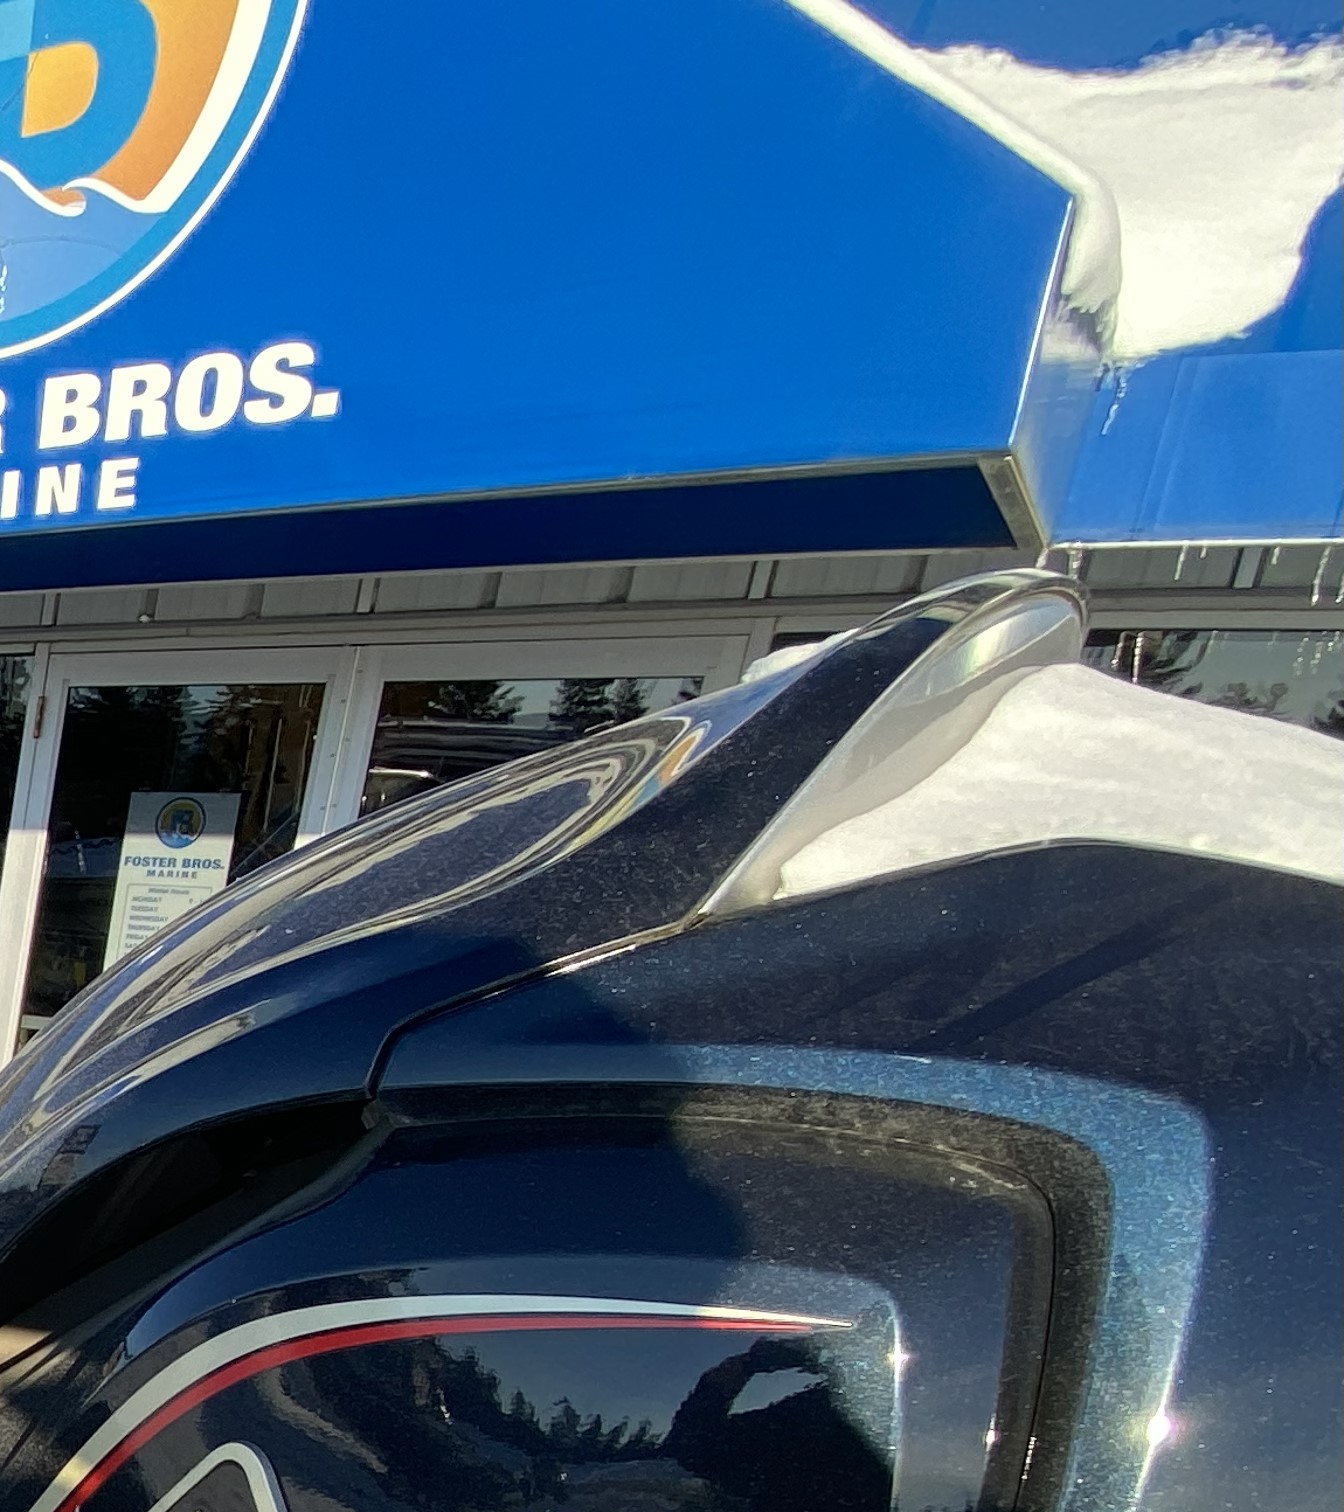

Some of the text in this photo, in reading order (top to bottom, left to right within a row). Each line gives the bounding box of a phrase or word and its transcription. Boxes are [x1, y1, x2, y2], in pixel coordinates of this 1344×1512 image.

[37, 340, 341, 451] BROS.
[123, 855, 225, 870] FOSTER BROS.
[146, 869, 198, 880] MARINE
